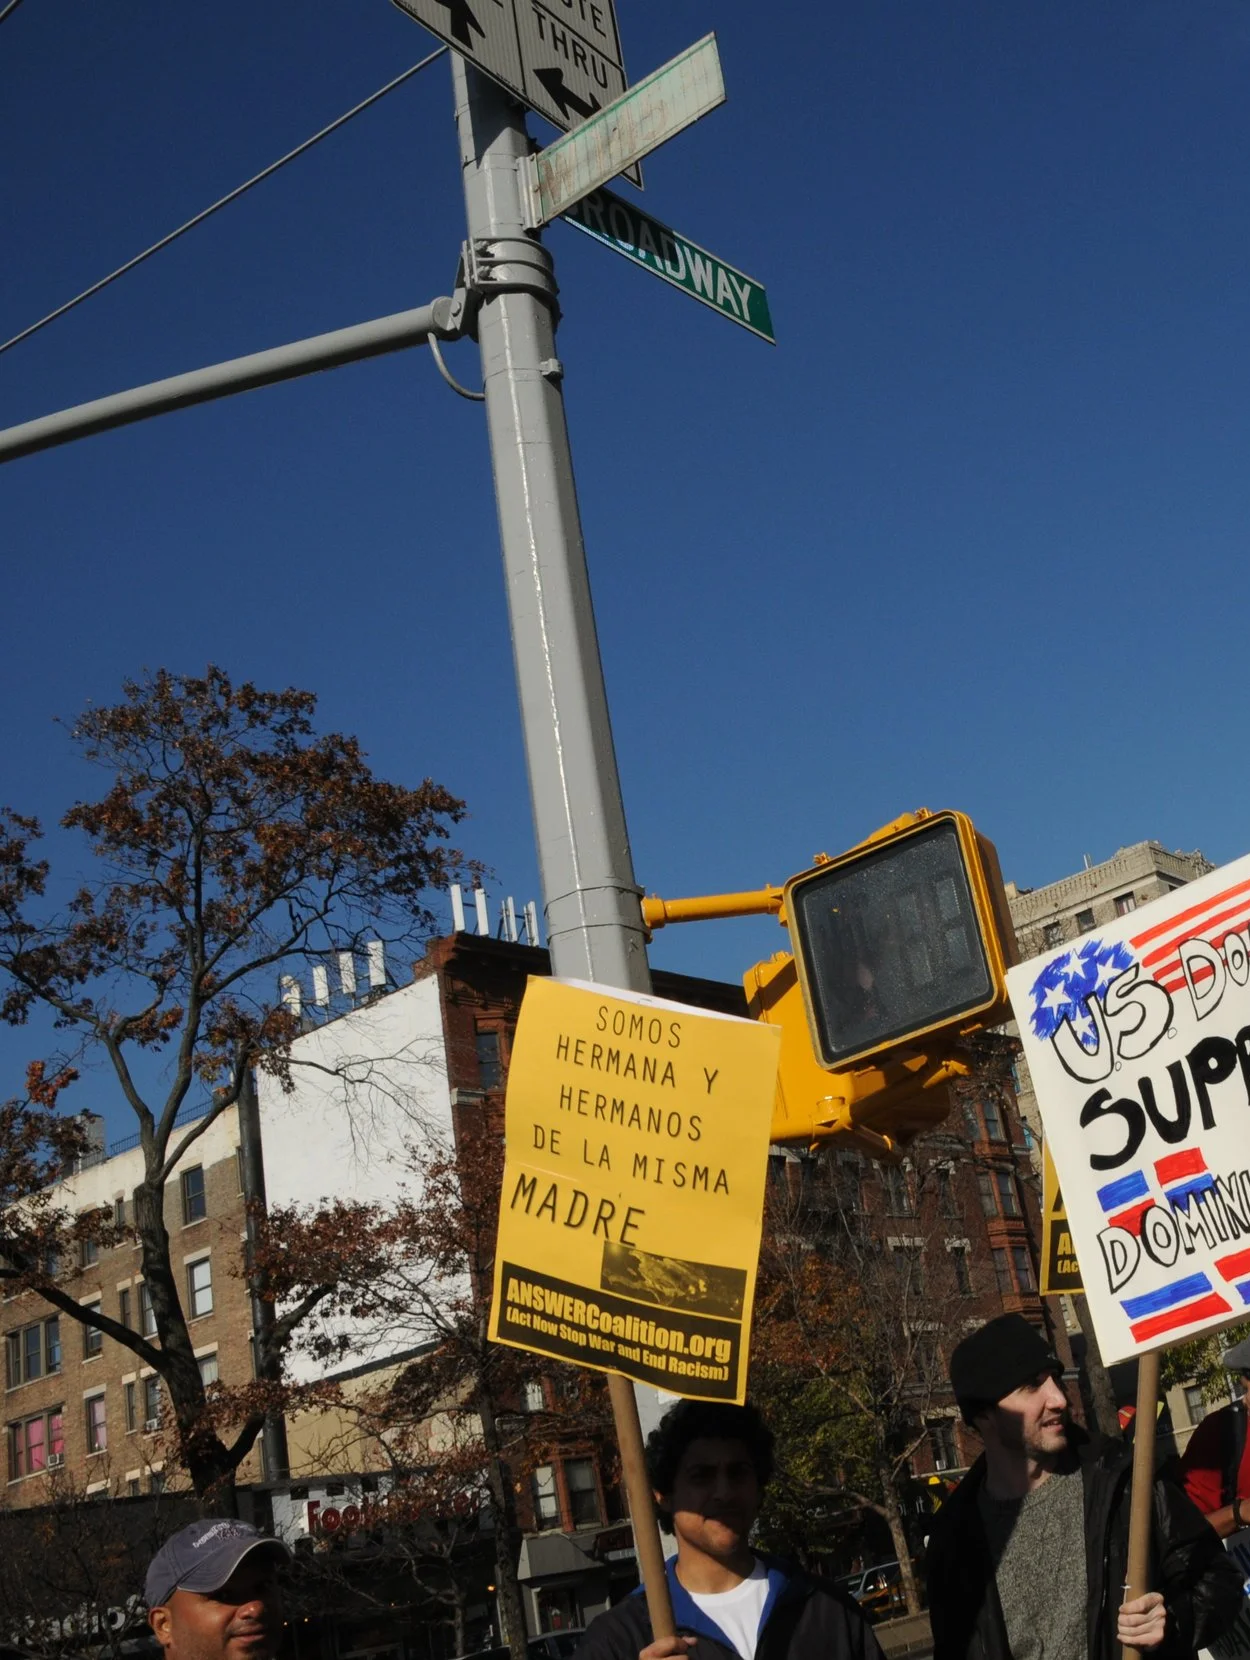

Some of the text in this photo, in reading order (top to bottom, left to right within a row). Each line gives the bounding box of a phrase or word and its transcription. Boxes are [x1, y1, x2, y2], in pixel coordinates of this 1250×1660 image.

[532, 7, 608, 89] THRU
[567, 194, 751, 322] ROADWAY
[595, 1005, 682, 1049] SOMOS
[1052, 962, 1179, 1083] U.S.
[555, 1034, 719, 1094] HERMANA Y
[559, 1085, 703, 1142] HERMANOS
[533, 1124, 730, 1195] DE LA MISMA
[510, 1172, 646, 1248] MADRE
[506, 1277, 732, 1363] ANSWERCoalition.org
[506, 1305, 729, 1382] (Act Now Stop War and End Racism)
